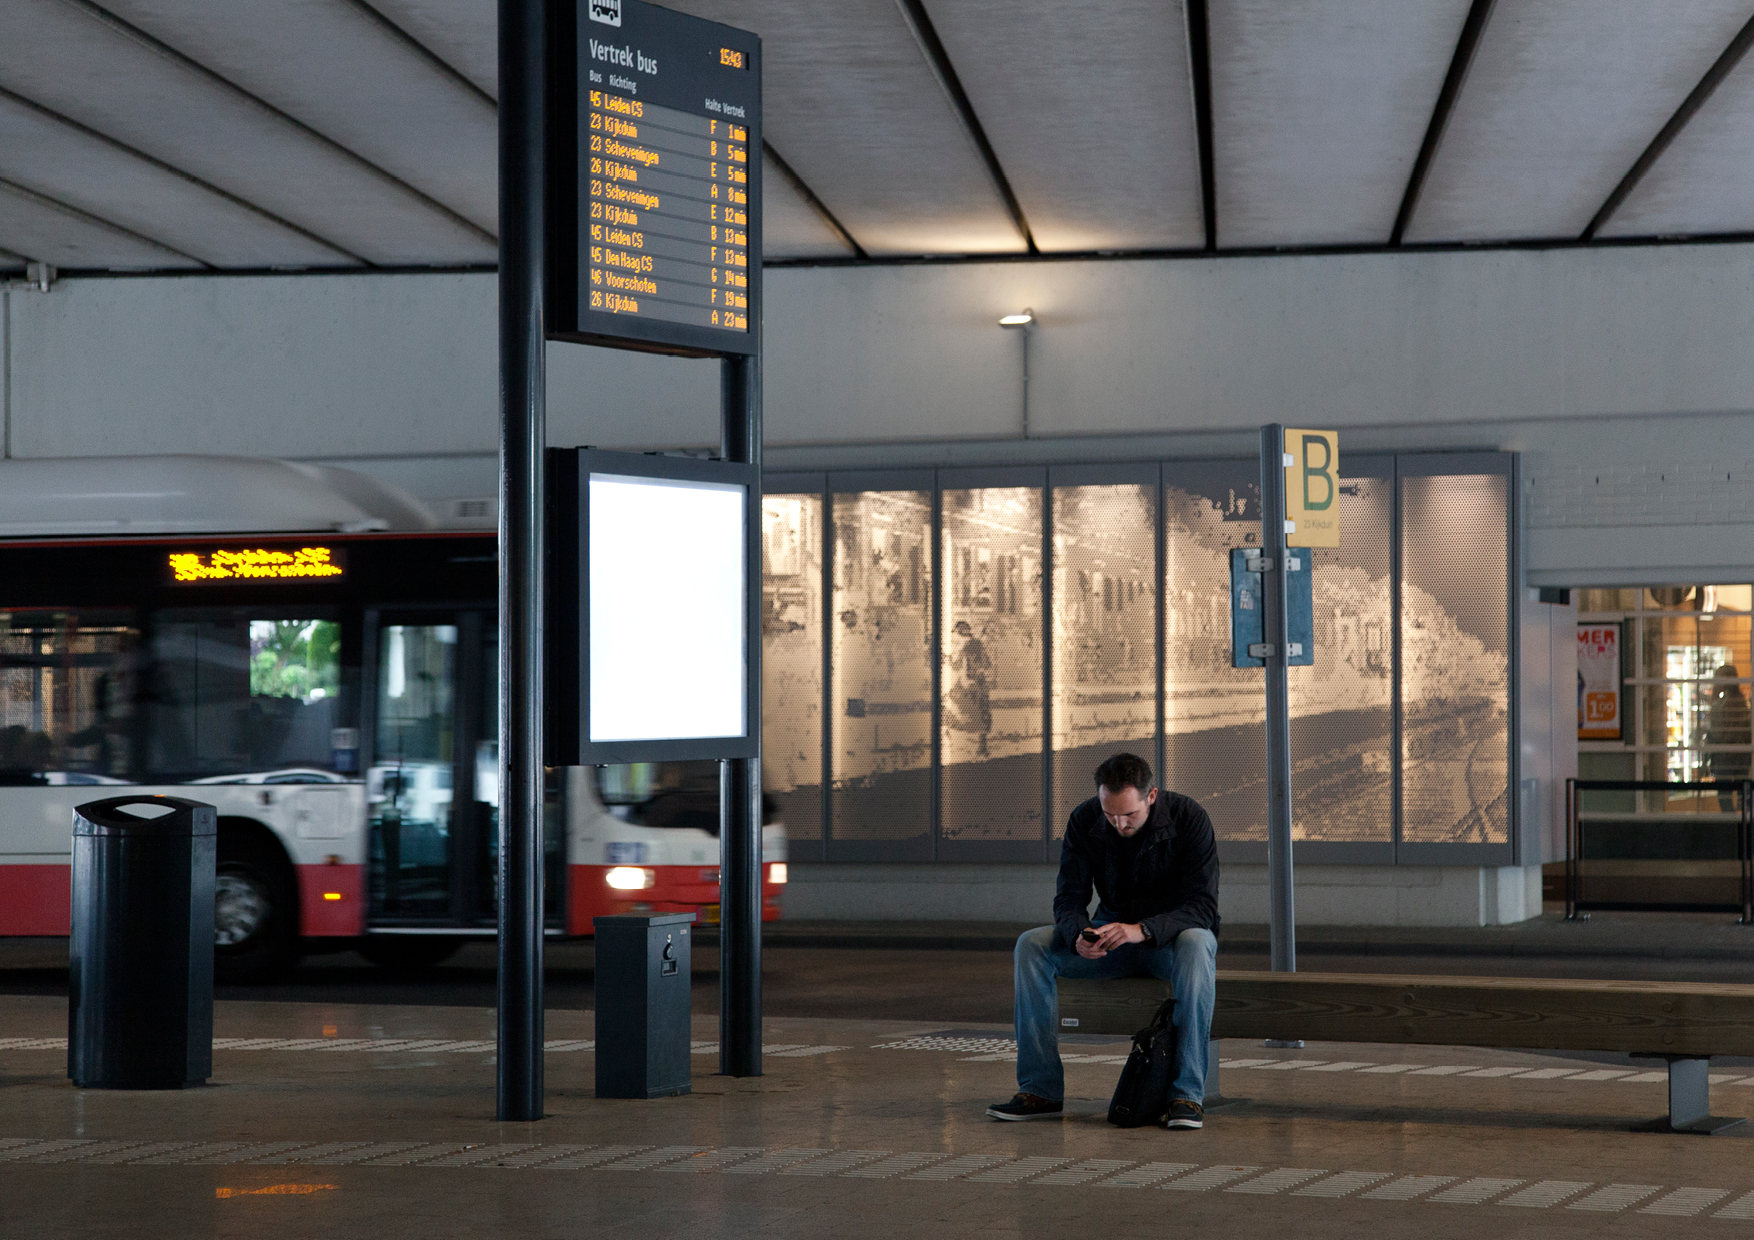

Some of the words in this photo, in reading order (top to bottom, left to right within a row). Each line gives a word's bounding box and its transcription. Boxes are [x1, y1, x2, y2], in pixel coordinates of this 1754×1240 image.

[589, 38, 634, 68] Vertrek
[637, 50, 658, 75] bus
[589, 69, 602, 84] Bus
[609, 74, 637, 95] Richting
[705, 97, 721, 113] Halte
[722, 102, 745, 119] Vertrek
[631, 101, 642, 117] CS
[711, 120, 716, 134] F
[711, 141, 716, 156] B
[711, 162, 716, 177] E
[711, 184, 718, 198] A
[711, 205, 716, 219] E
[711, 226, 717, 240] B
[632, 232, 643, 248] CS
[712, 247, 716, 260] F
[641, 256, 652, 271] CS
[712, 268, 717, 282] G
[712, 289, 717, 302] F
[712, 310, 718, 324] A
[1302, 434, 1333, 511] B
